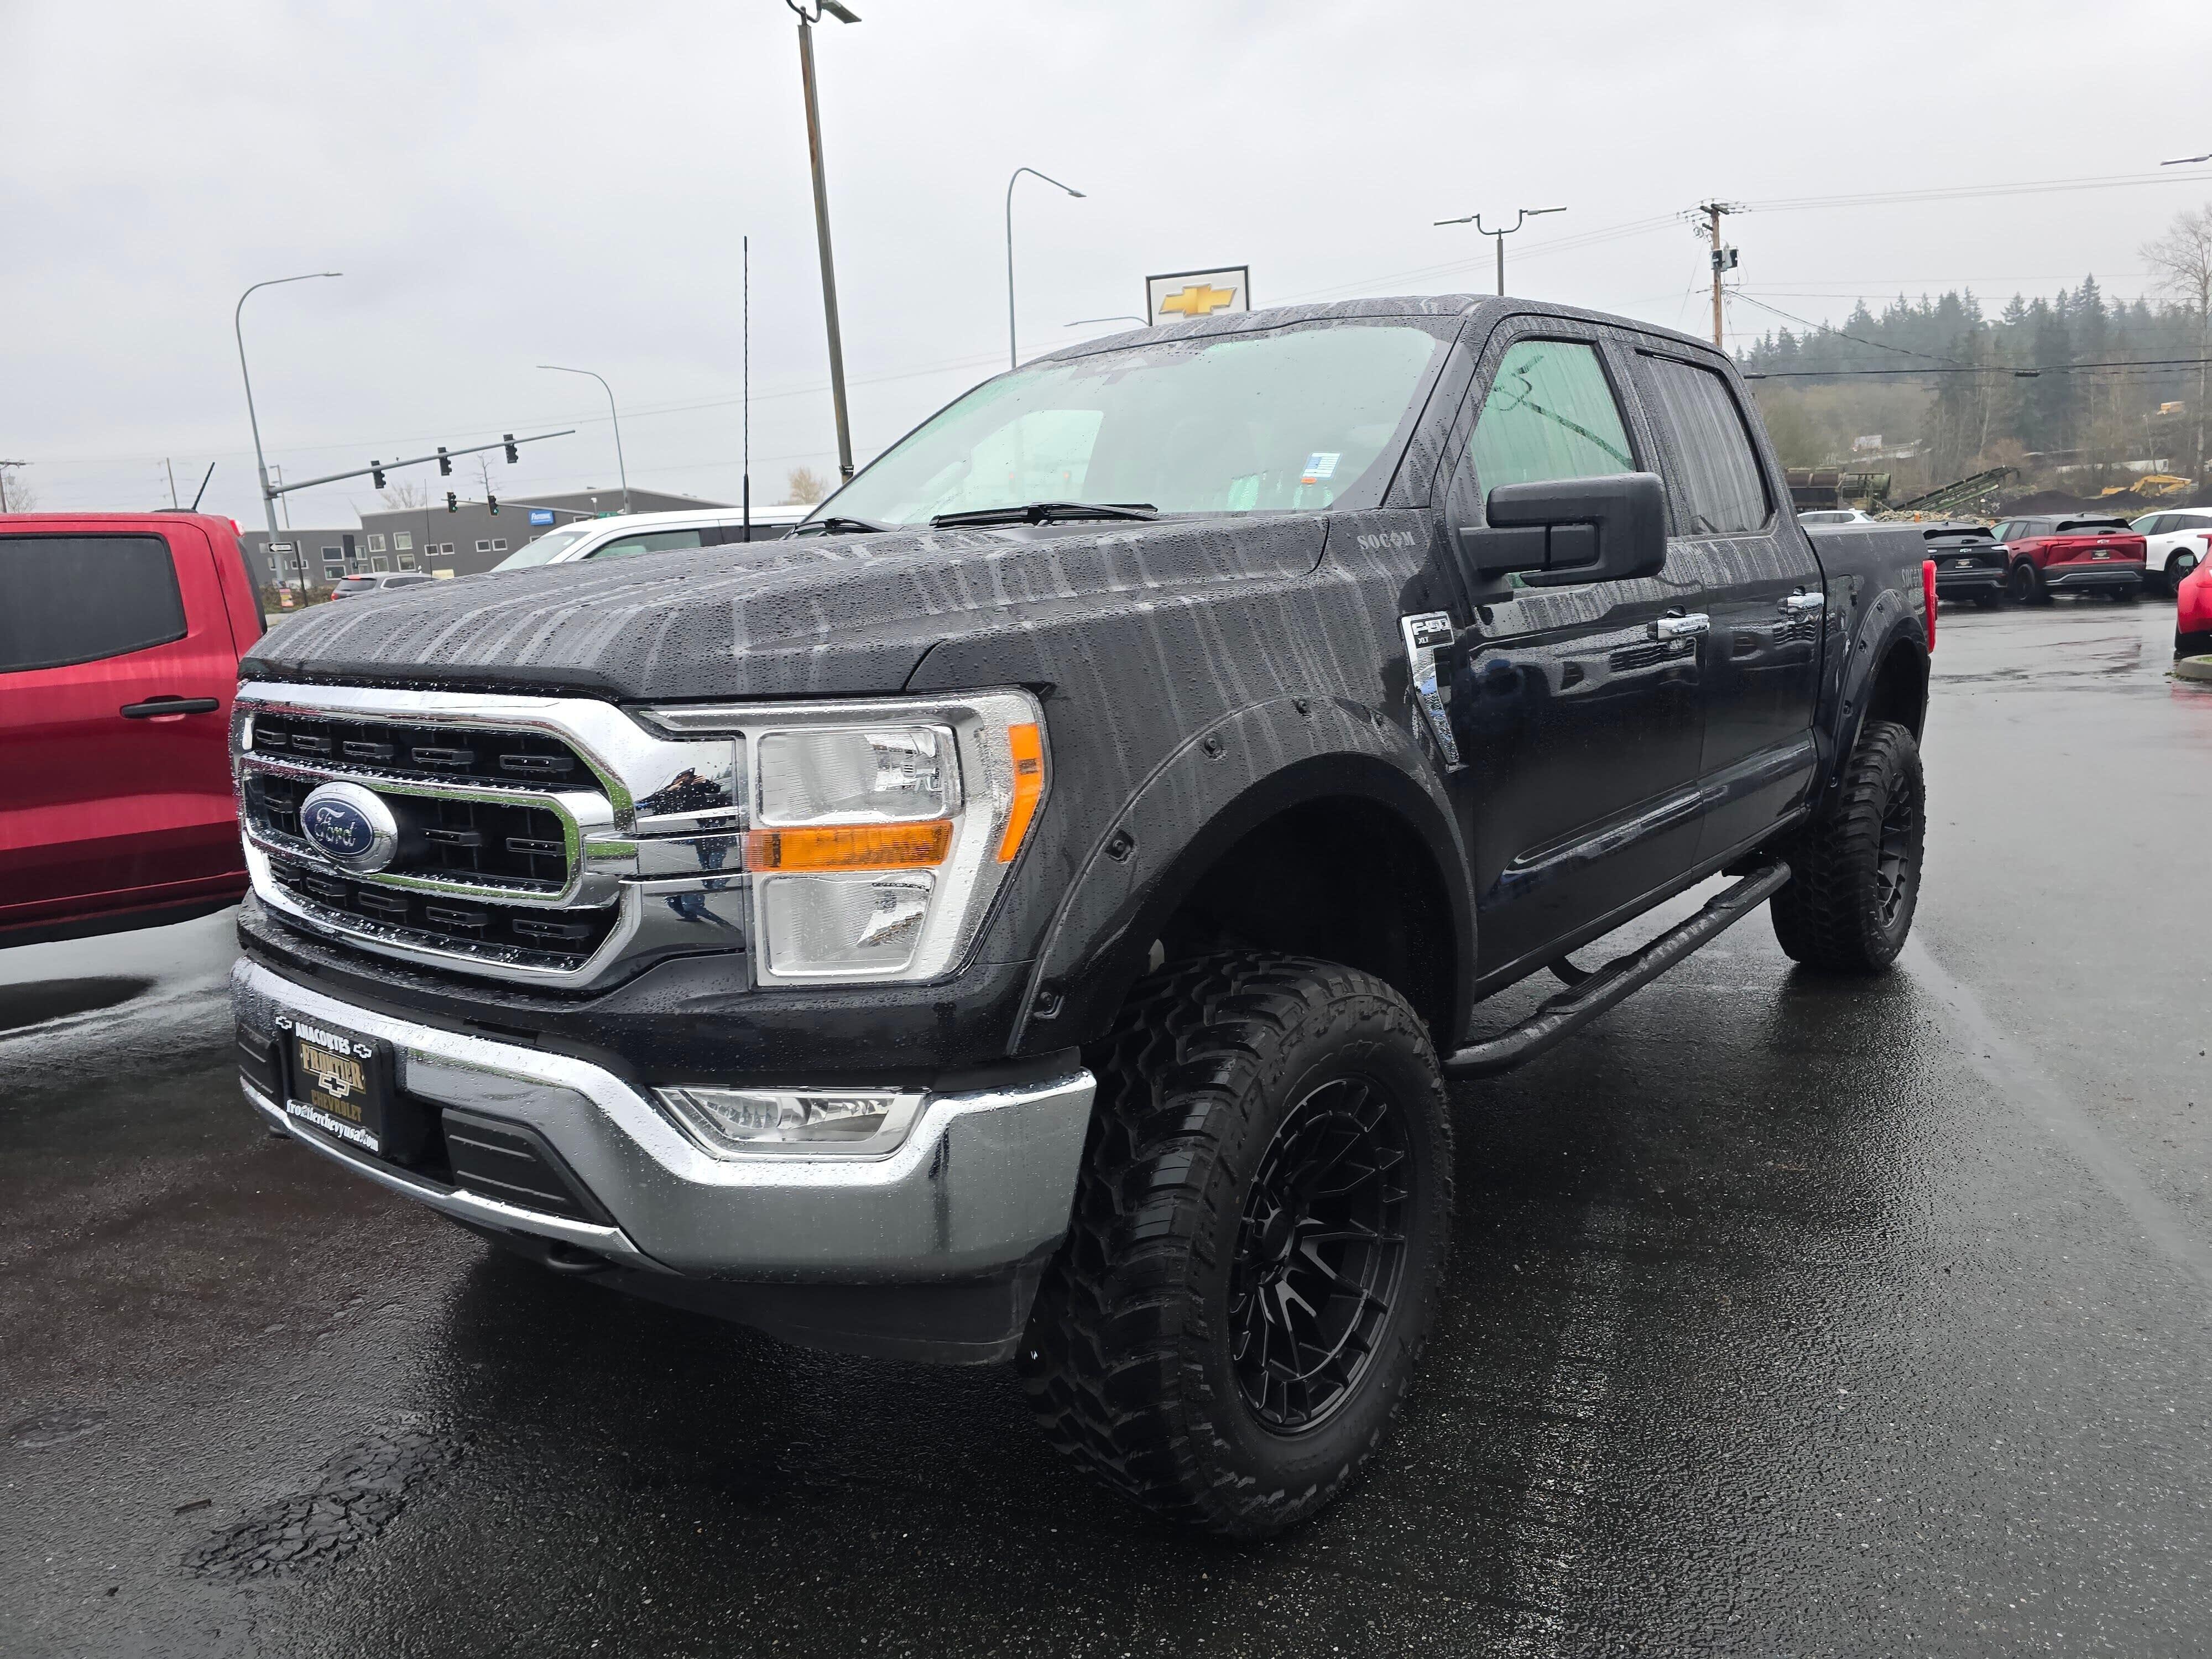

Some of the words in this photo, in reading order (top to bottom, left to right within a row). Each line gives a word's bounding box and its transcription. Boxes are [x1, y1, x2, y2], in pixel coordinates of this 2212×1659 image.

[1357, 530, 1416, 550] SOCOM
[314, 806, 357, 847] Ford
[295, 1022, 351, 1055] ANACORTES
[301, 1043, 364, 1091] FRONTIER
[310, 1089, 362, 1122] CHEVROLET
